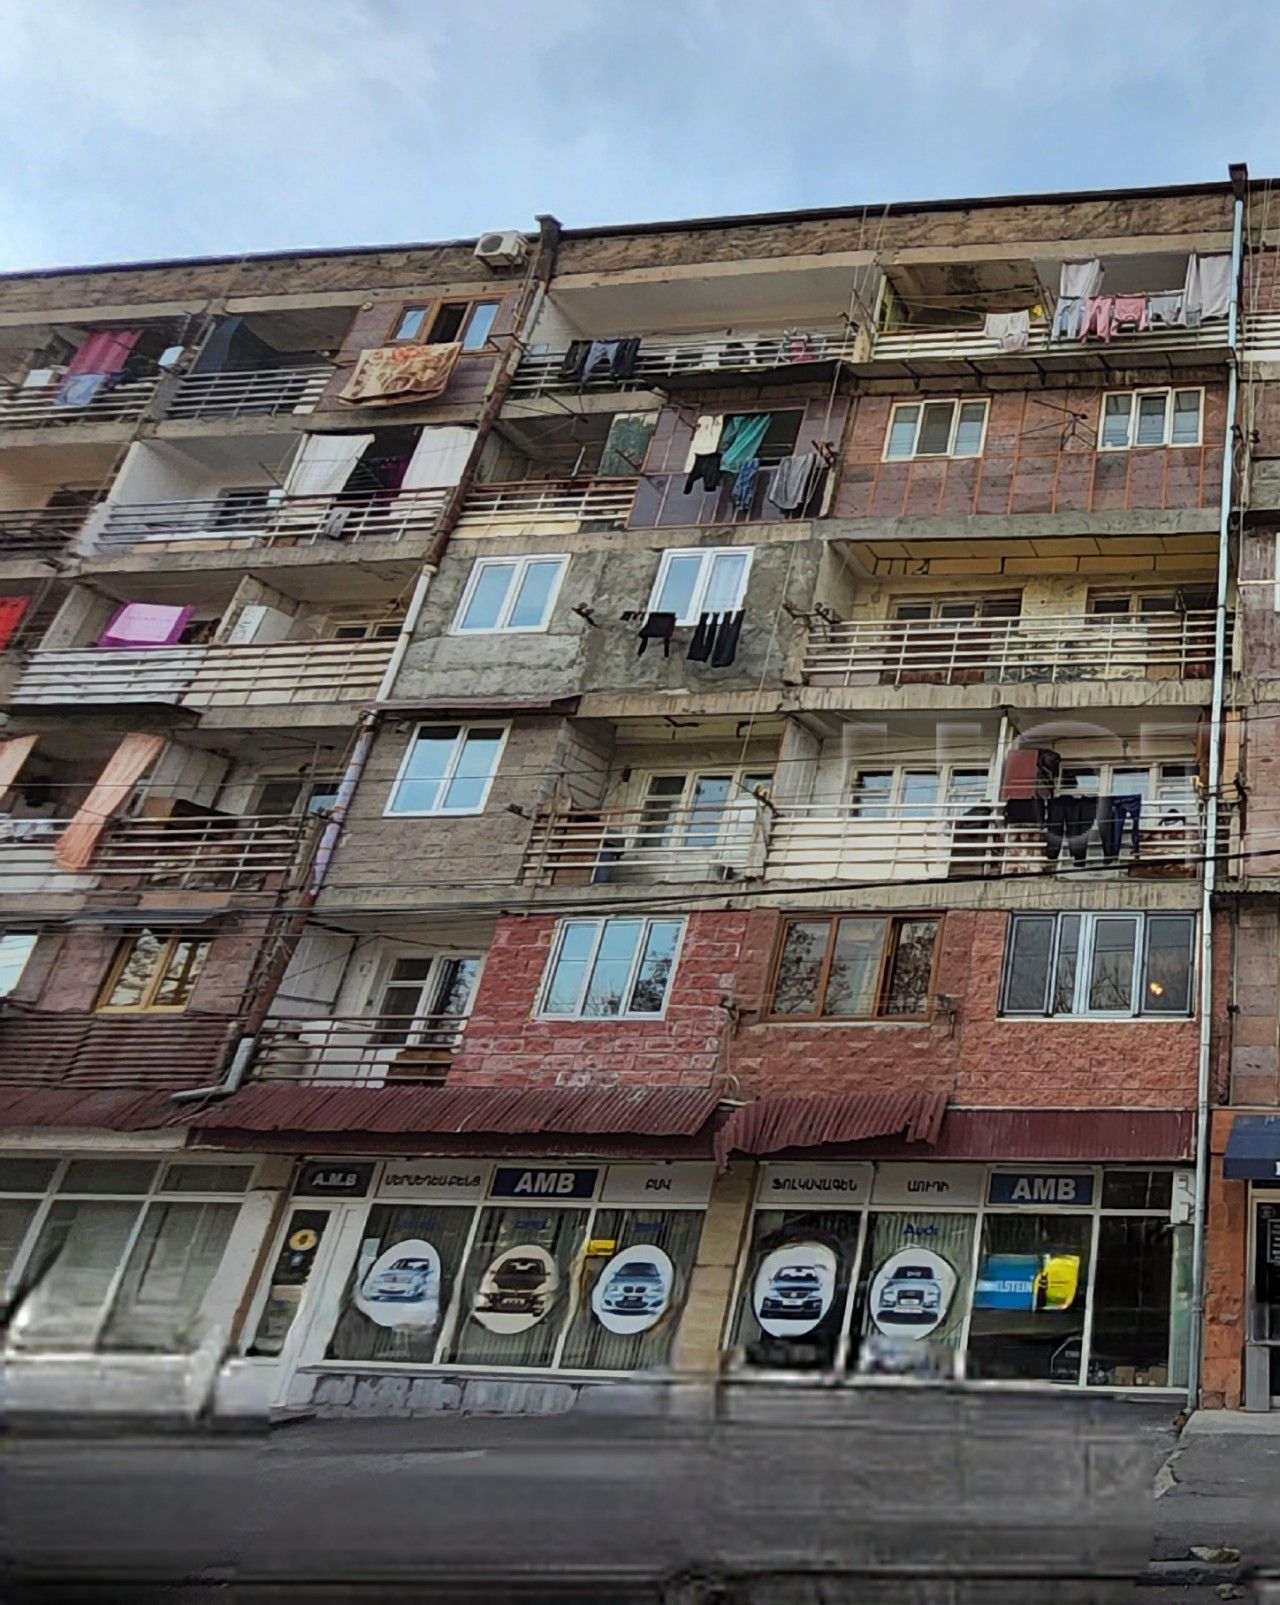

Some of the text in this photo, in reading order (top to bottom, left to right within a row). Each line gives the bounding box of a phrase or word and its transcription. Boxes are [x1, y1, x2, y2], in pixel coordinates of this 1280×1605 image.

[312, 1172, 357, 1187] A.M.B
[513, 1172, 576, 1194] AMB
[1010, 1178, 1076, 1200] AMB
